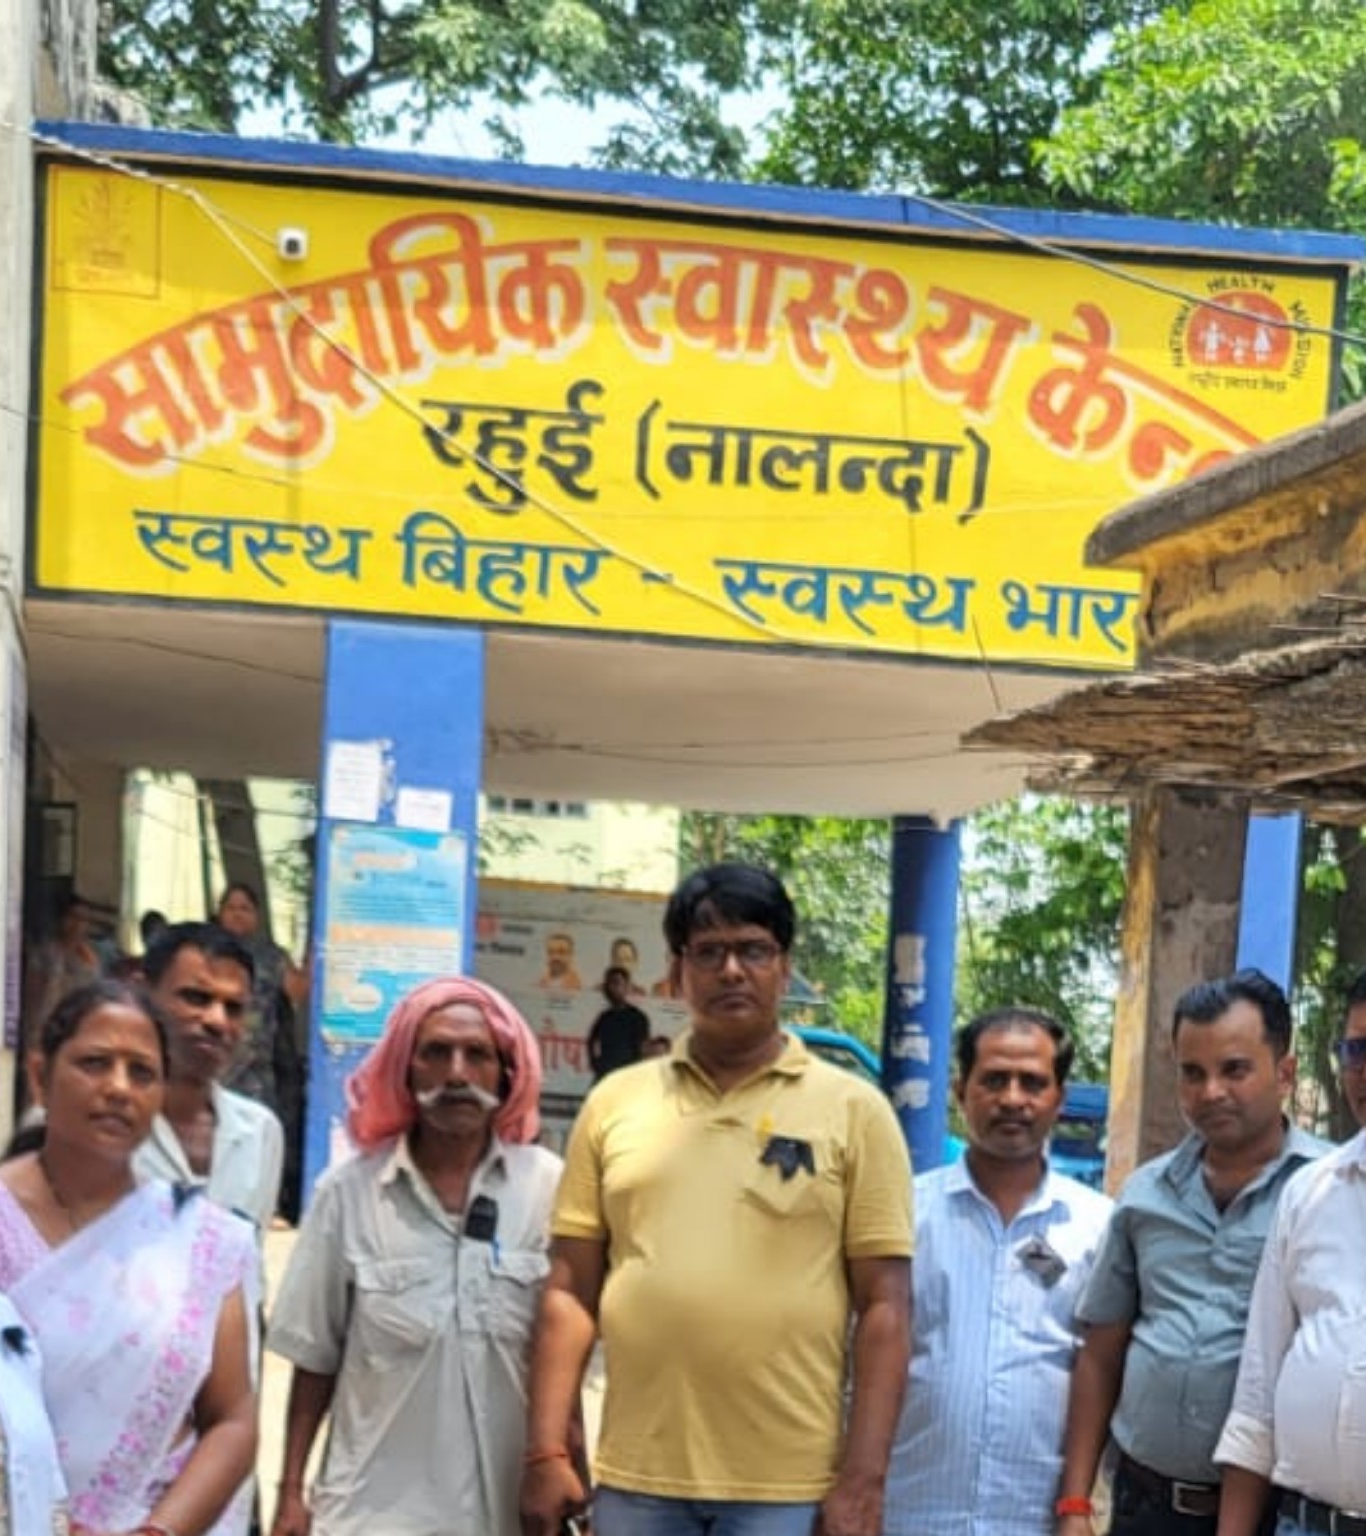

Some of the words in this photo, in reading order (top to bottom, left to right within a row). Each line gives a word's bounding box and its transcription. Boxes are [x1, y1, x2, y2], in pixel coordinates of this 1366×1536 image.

[58, 211, 585, 466] सामुदायिक
[604, 236, 1032, 414] स्वास्थ्य
[419, 379, 605, 514] रहुई
[635, 400, 992, 525] (नालन्दा)
[132, 509, 373, 588] स्वस्थ
[393, 511, 615, 616] बिहार
[713, 558, 976, 636] स्वस्थ
